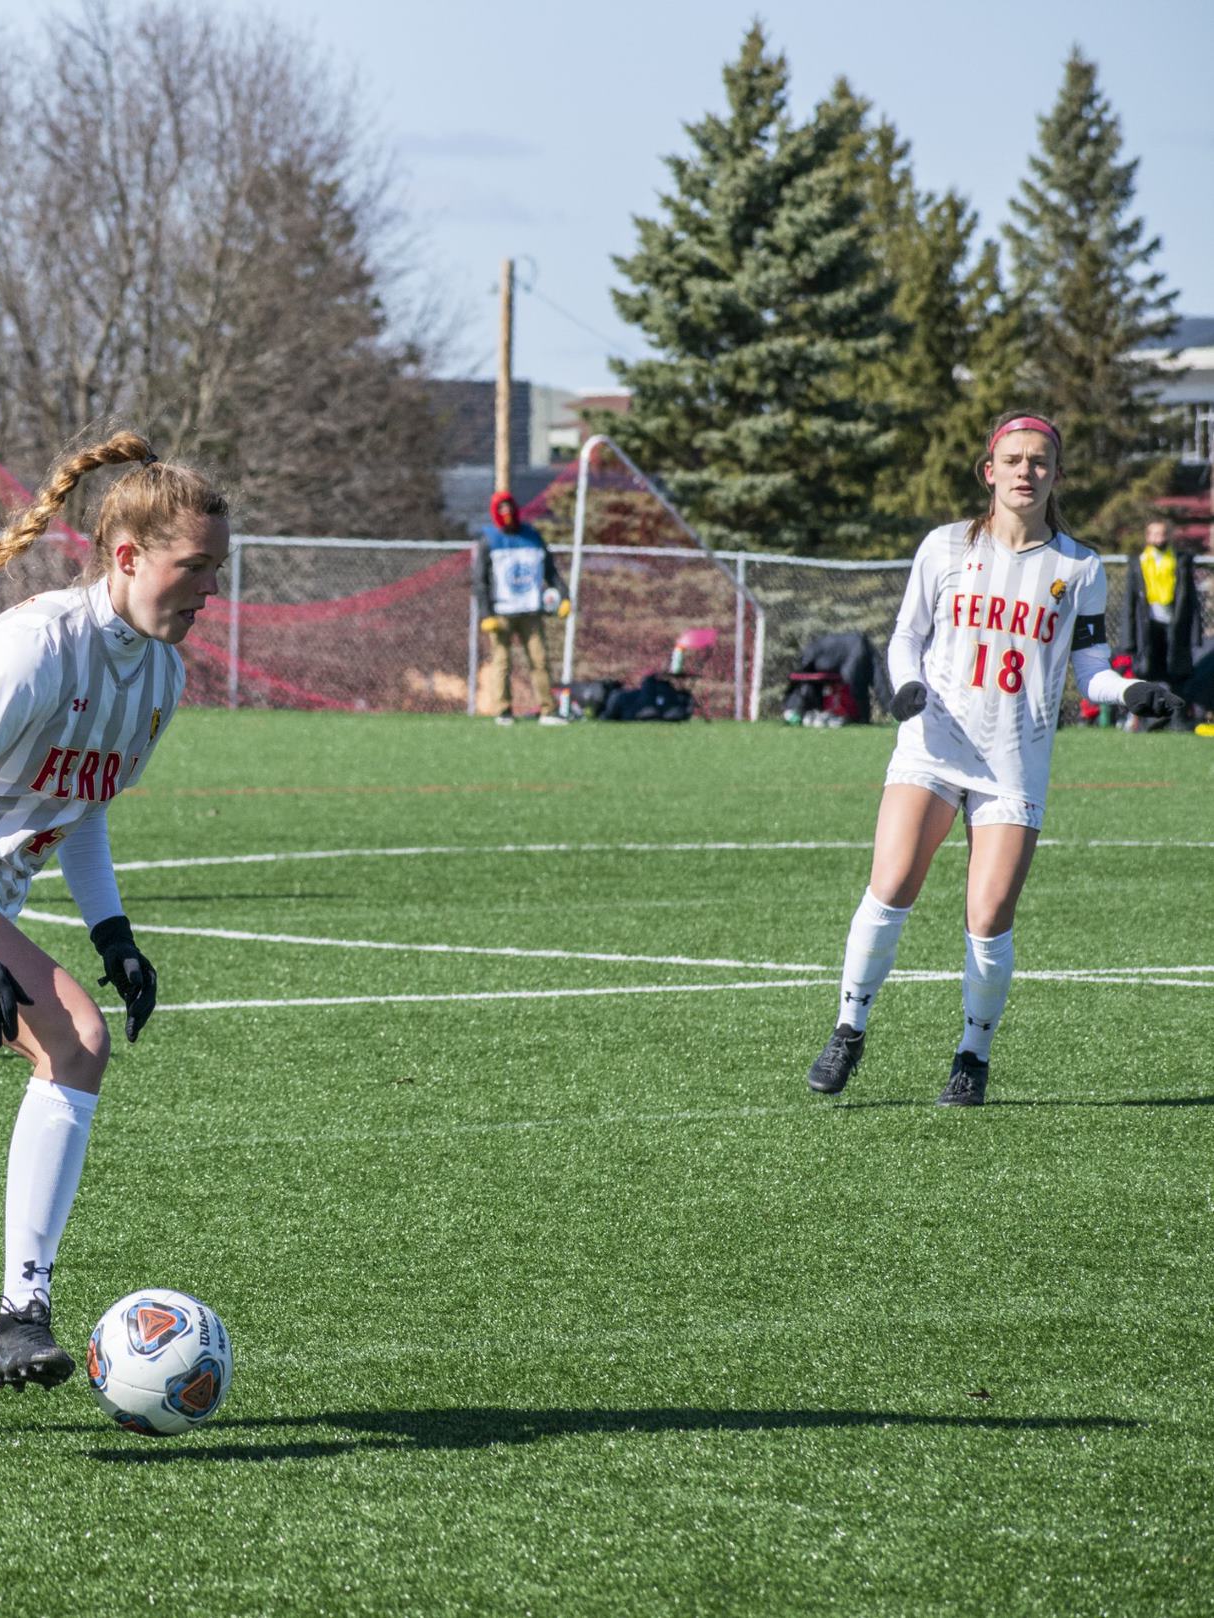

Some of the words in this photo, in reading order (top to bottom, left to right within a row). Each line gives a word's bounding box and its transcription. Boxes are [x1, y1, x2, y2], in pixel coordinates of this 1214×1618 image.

[952, 593, 1060, 644] FERRIS
[970, 642, 1026, 695] 18
[197, 1305, 211, 1347] Wilson
